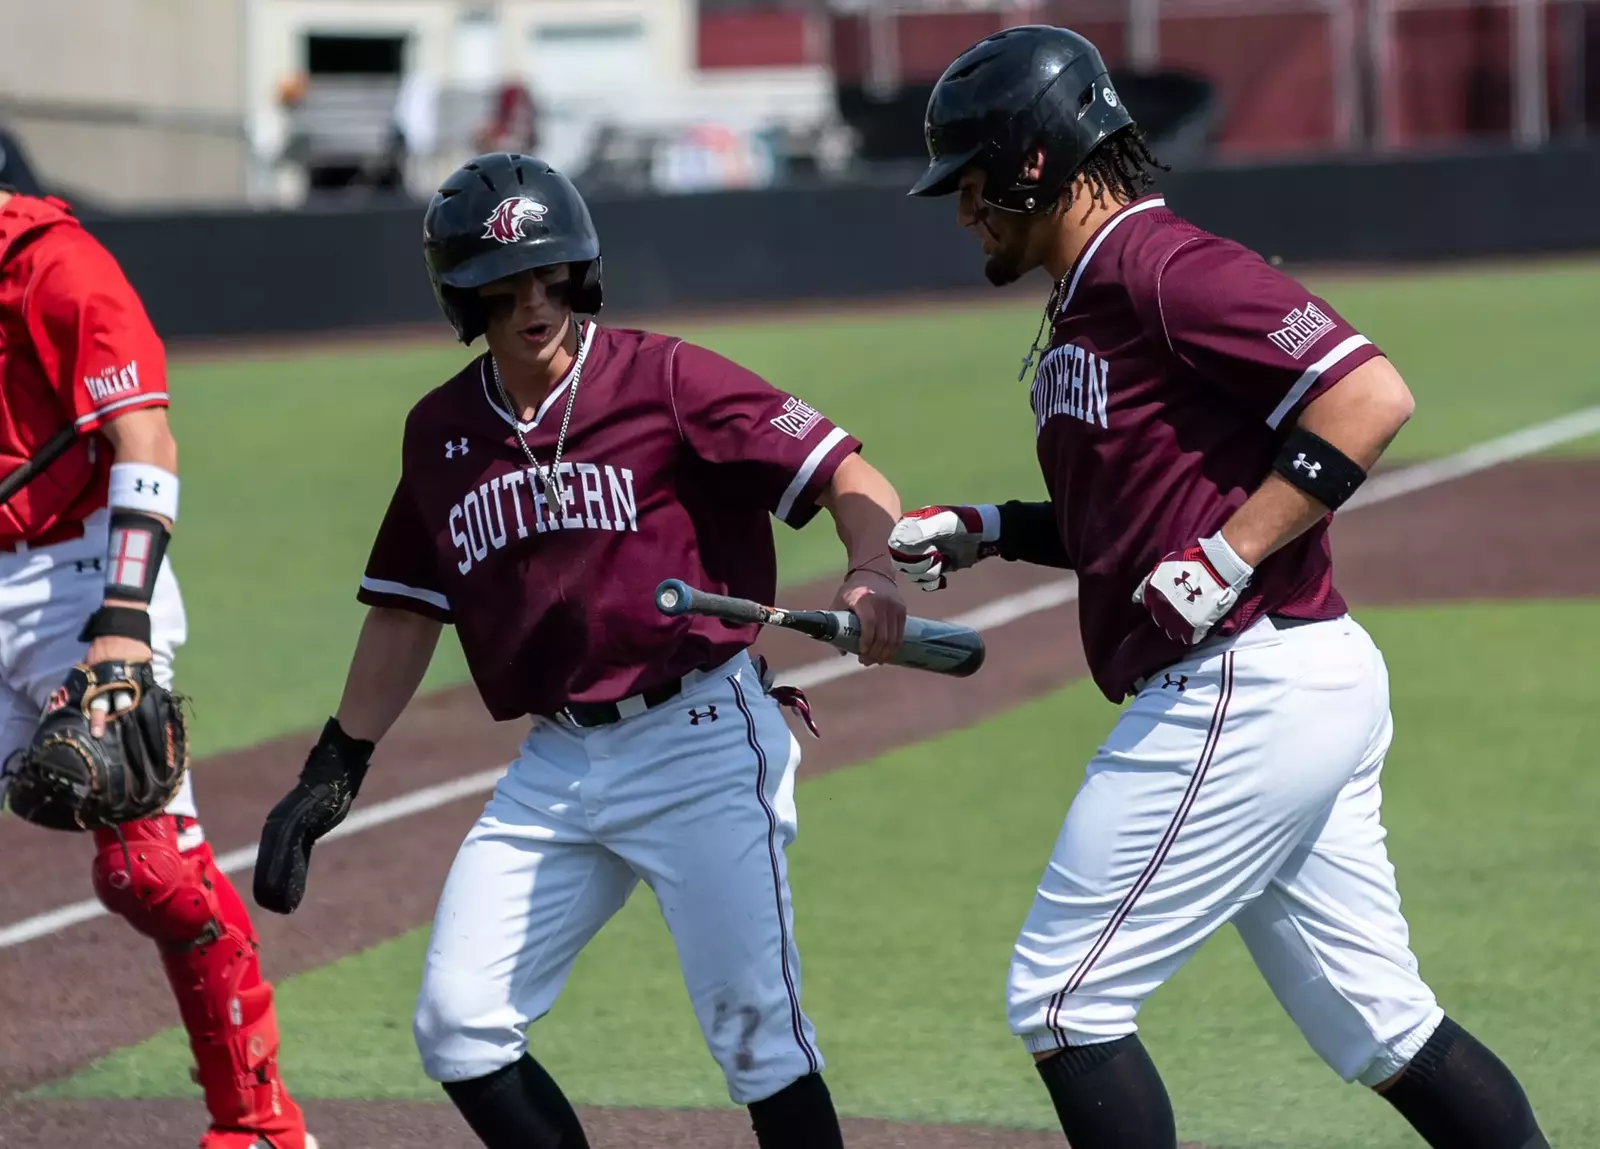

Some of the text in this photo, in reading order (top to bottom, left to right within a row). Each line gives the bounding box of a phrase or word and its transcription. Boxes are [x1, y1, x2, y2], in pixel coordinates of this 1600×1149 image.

[1267, 302, 1332, 356] VALLEY
[1282, 308, 1303, 326] THE
[84, 360, 139, 401] VALLEY
[1031, 344, 1108, 437] OUTHERN
[449, 462, 638, 575] SOUTHERN
